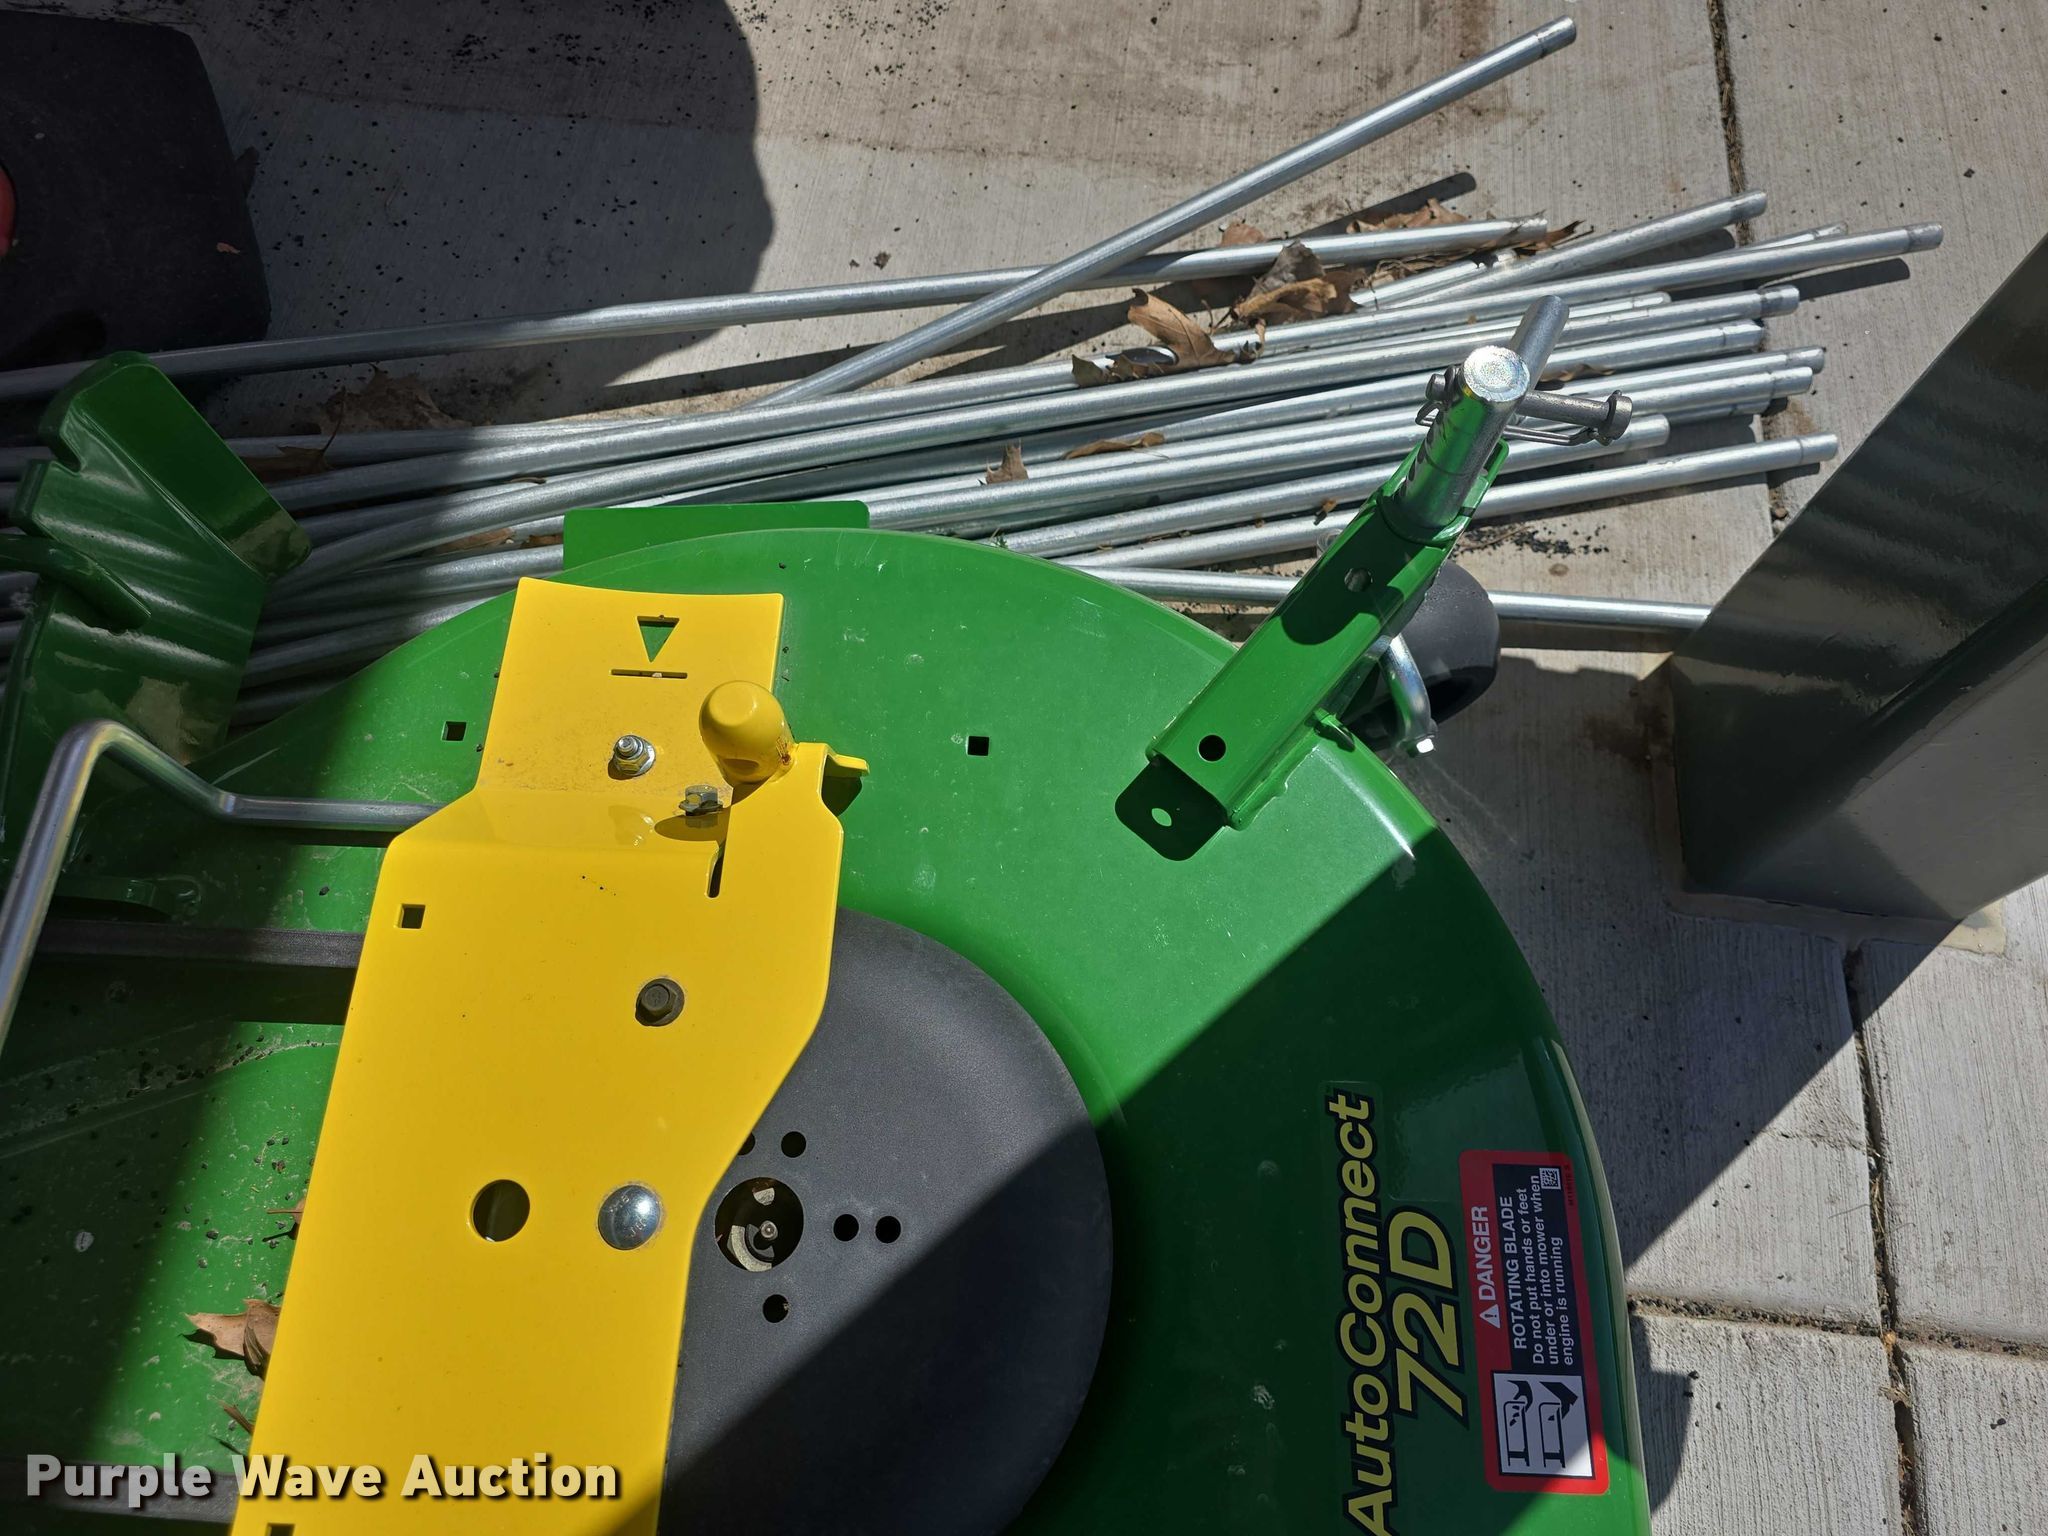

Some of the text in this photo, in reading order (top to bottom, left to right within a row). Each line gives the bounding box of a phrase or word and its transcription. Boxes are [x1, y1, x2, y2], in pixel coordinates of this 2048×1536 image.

[1327, 1093, 1393, 1536] AutoConnect
[1388, 1211, 1463, 1417] 72D
[1471, 1206, 1496, 1300] DANGER
[1500, 1196, 1527, 1349] ROTATING BLADE
[1516, 1188, 1545, 1364] Do not put hands or feet
[1530, 1175, 1559, 1364] under or into mower when
[1550, 1237, 1574, 1366] engine is running
